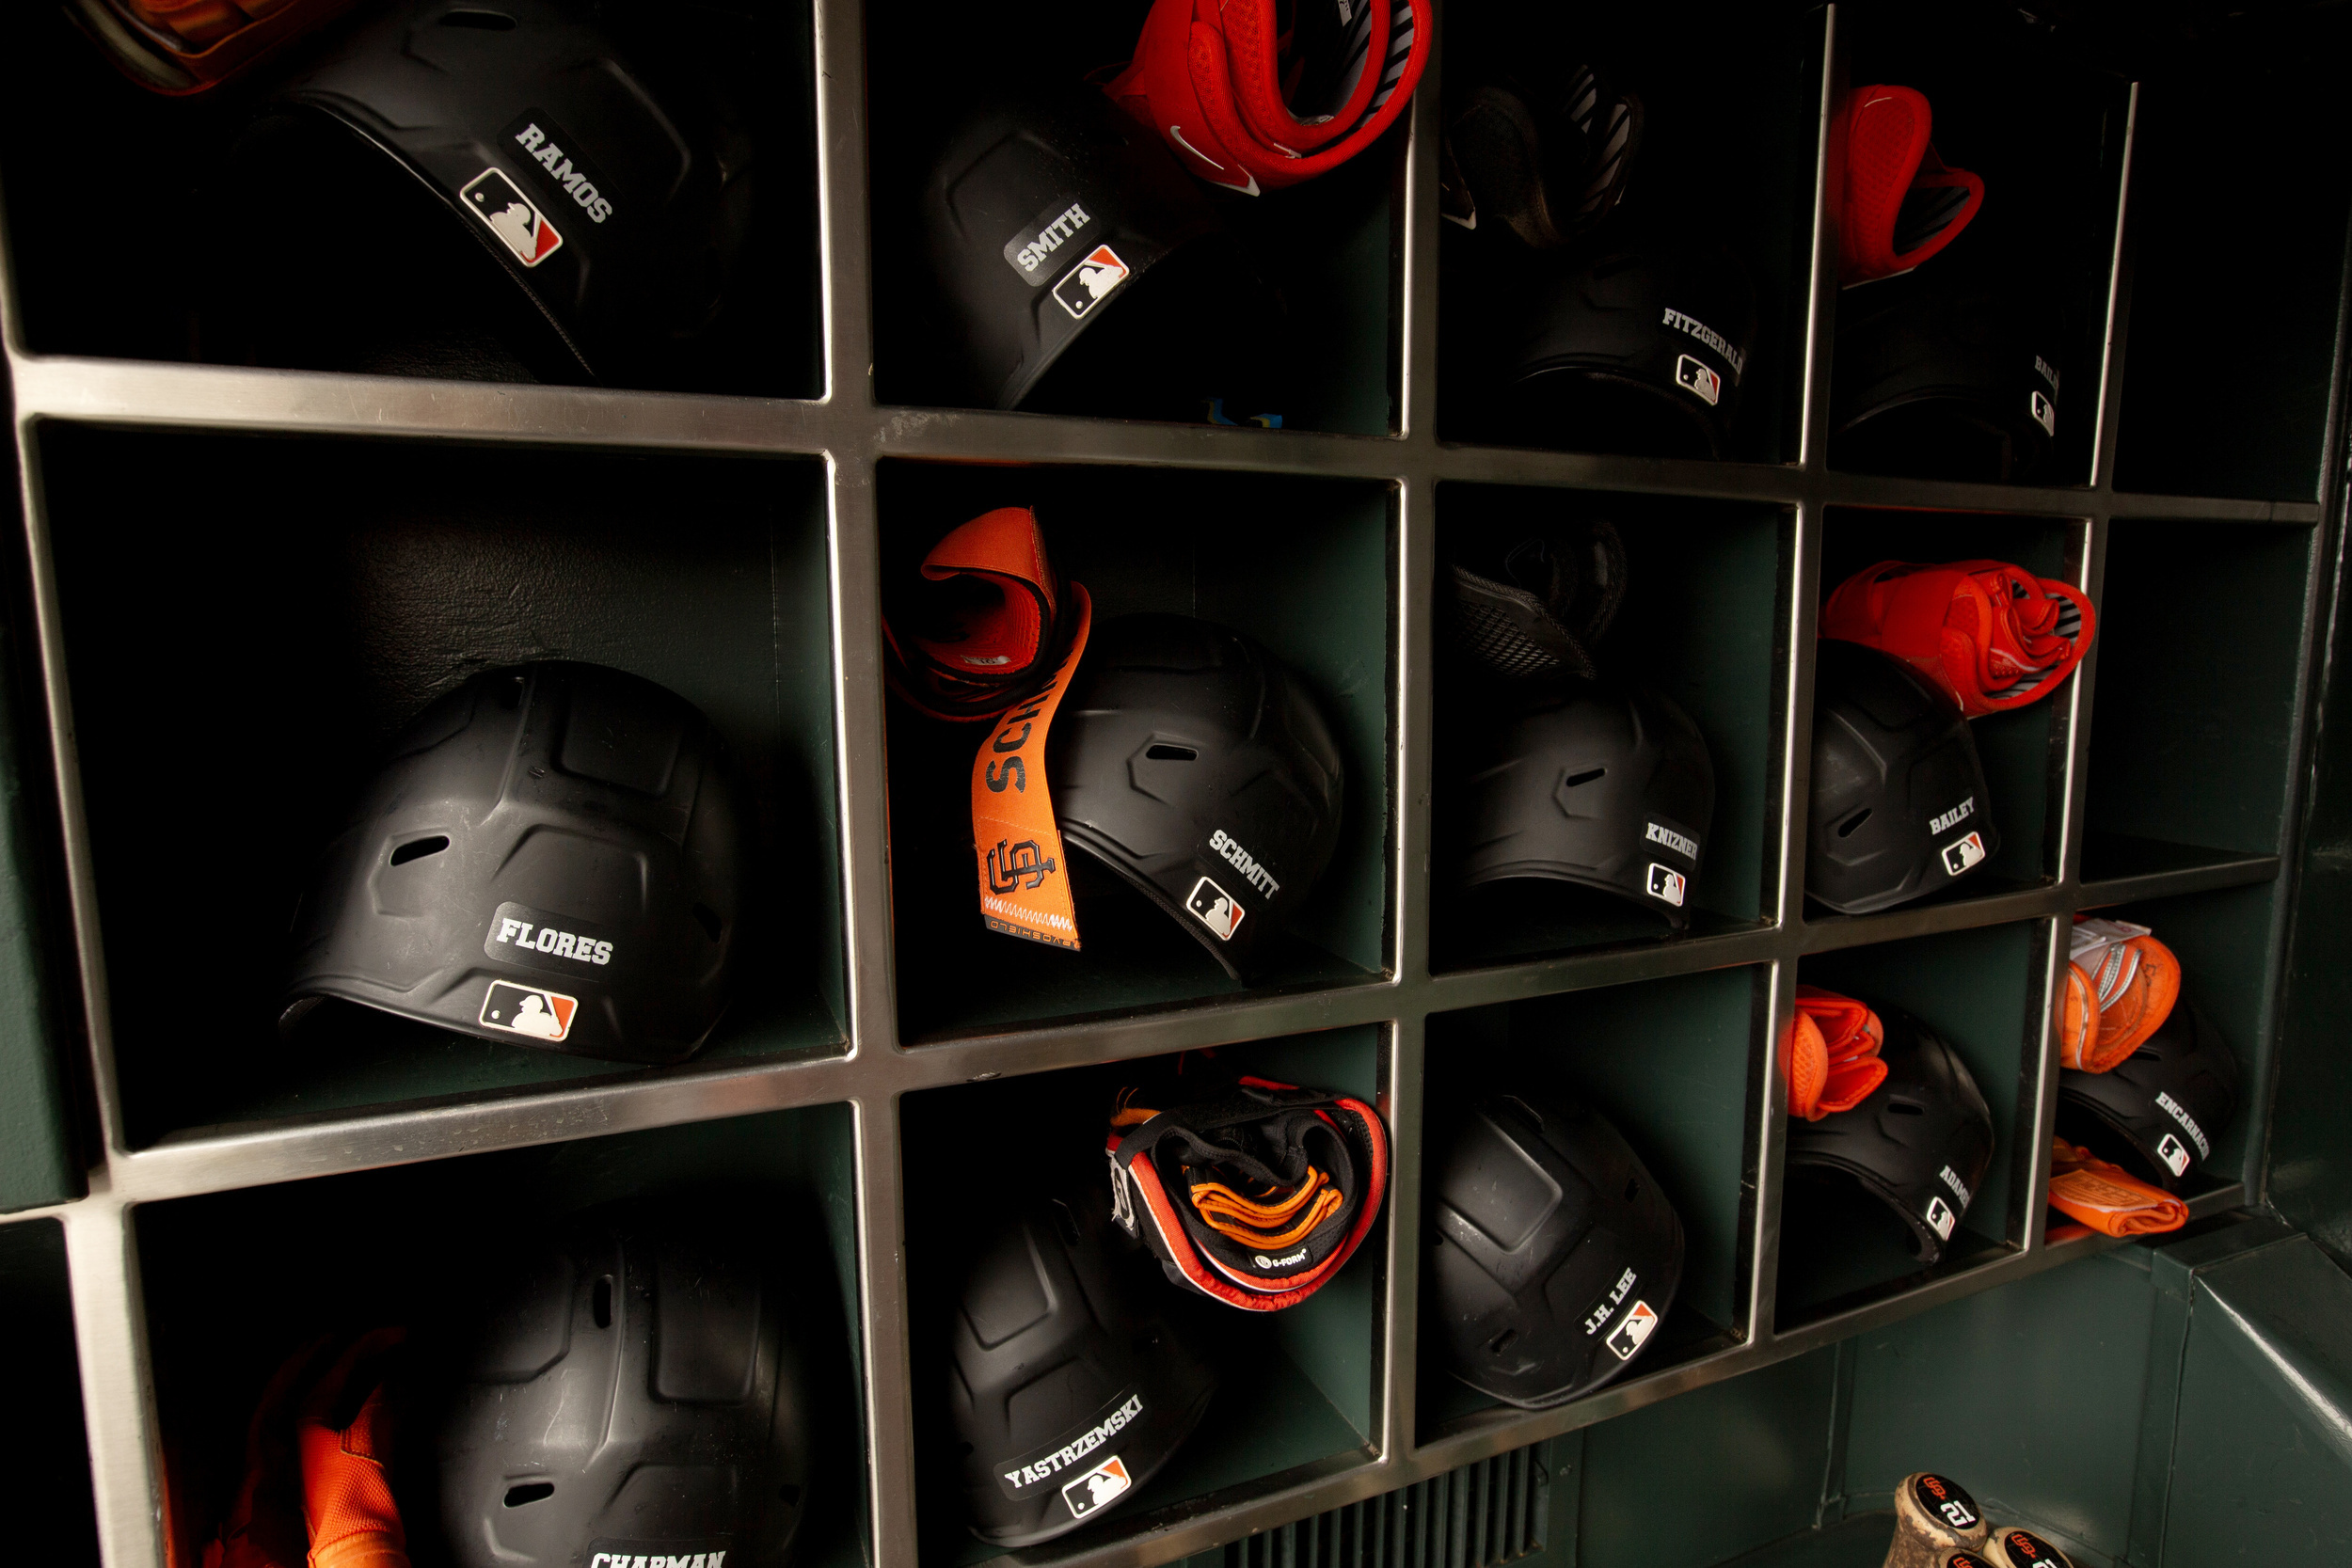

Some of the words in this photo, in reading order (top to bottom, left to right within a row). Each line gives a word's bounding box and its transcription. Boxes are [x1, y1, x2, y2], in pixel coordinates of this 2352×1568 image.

[515, 122, 613, 224] RAMOS
[1017, 202, 1091, 272] SMITH
[1662, 307, 1743, 375] FITZGERALD
[1645, 822, 1698, 861] KNIZNER
[1929, 796, 1975, 836] BAILEY
[1209, 829, 1280, 900] SCHMITT
[496, 917, 614, 966] FLORES
[1584, 1304, 1615, 1336] J.H.
[1609, 1266, 1637, 1306] LEE
[1004, 1393, 1143, 1489] YASTRZEMSKI
[1940, 1499, 1977, 1527] 21
